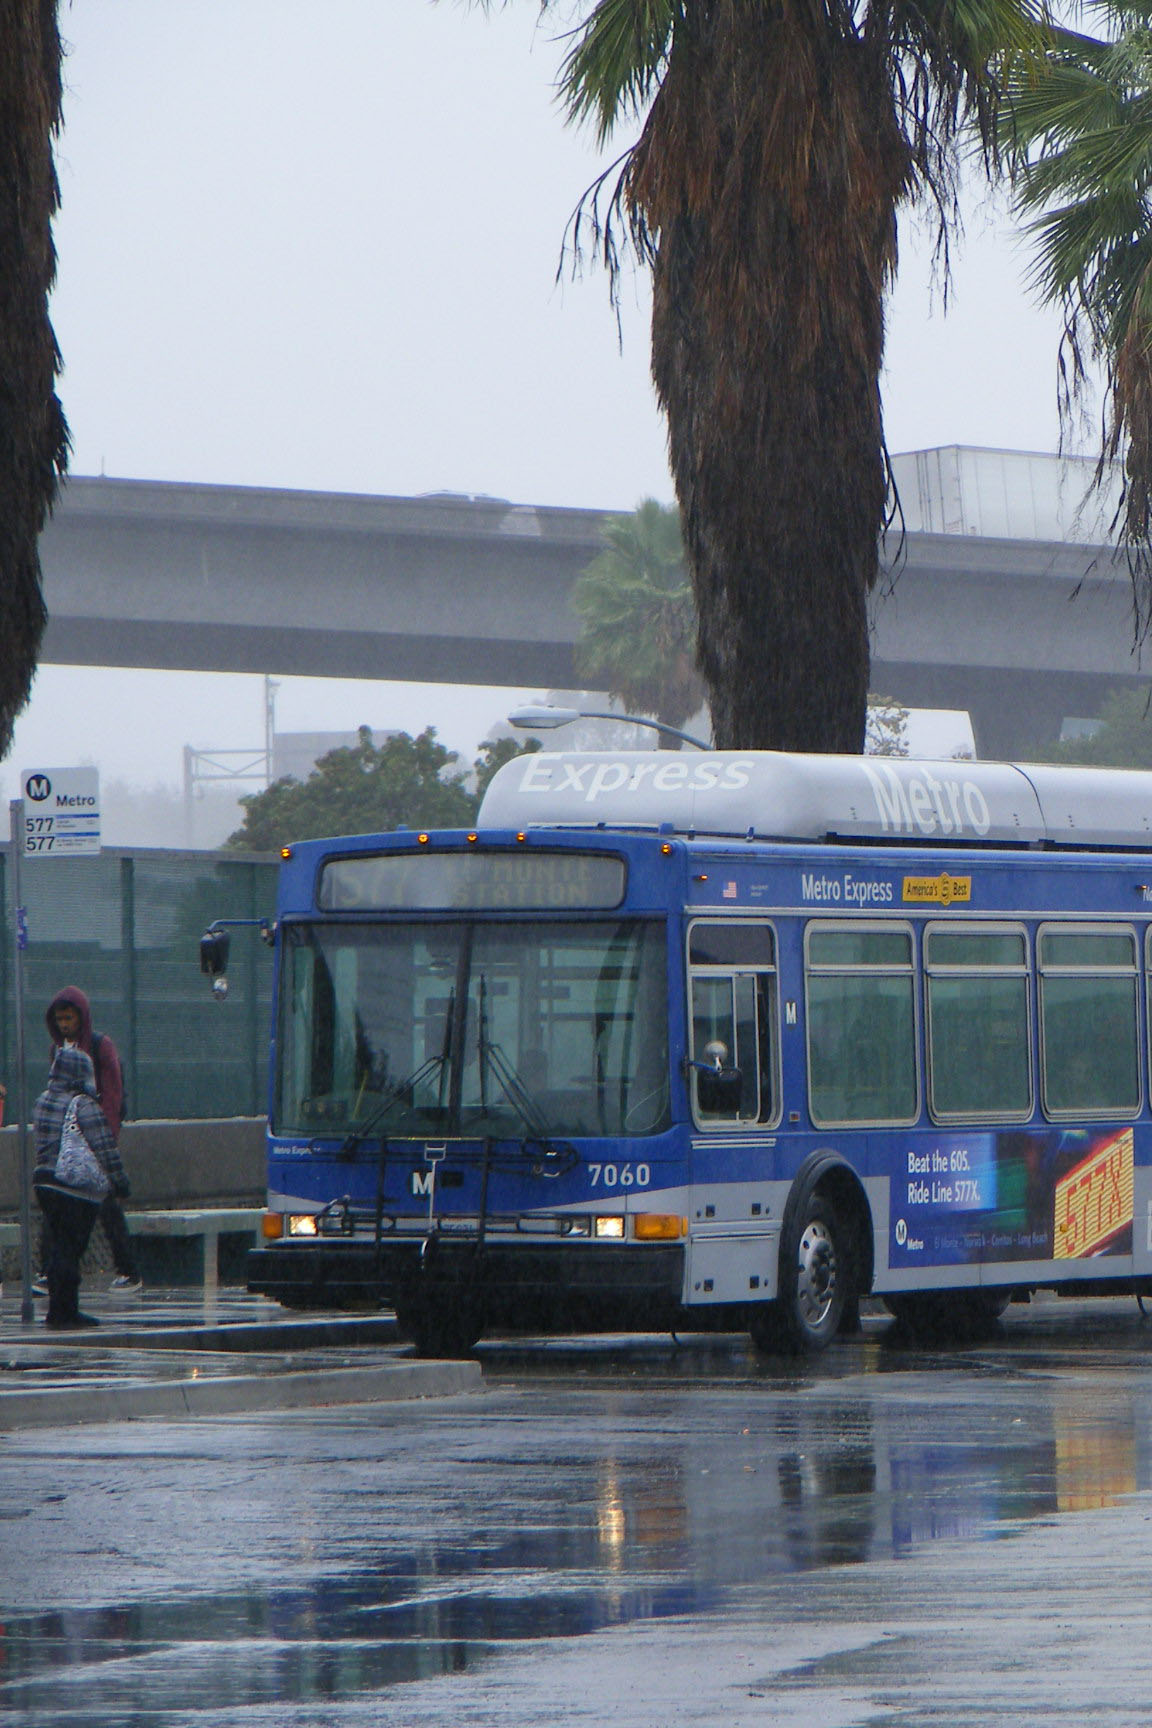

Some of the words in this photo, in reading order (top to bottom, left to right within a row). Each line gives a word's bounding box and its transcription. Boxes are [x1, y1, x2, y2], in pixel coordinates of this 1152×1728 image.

[28, 777, 49, 799] M
[518, 755, 756, 801] Express
[56, 794, 96, 806] Metro
[863, 763, 991, 836] Metro
[26, 817, 54, 832] 577
[26, 836, 55, 851] 577
[802, 874, 840, 900] Metro
[844, 874, 893, 907] Express
[907, 882, 938, 897] America's
[953, 881, 967, 896] Best
[786, 1001, 797, 1025] M
[908, 1152, 930, 1173] Beat
[932, 1150, 949, 1172] the
[950, 1150, 970, 1171] 605.
[412, 1172, 433, 1194] M
[588, 1164, 650, 1186] 7060
[908, 1182, 929, 1204] Ride
[932, 1181, 952, 1203] Line
[955, 1181, 980, 1202] 577X.
[1066, 1146, 1122, 1254] 577X
[907, 1238, 923, 1250] Metro
